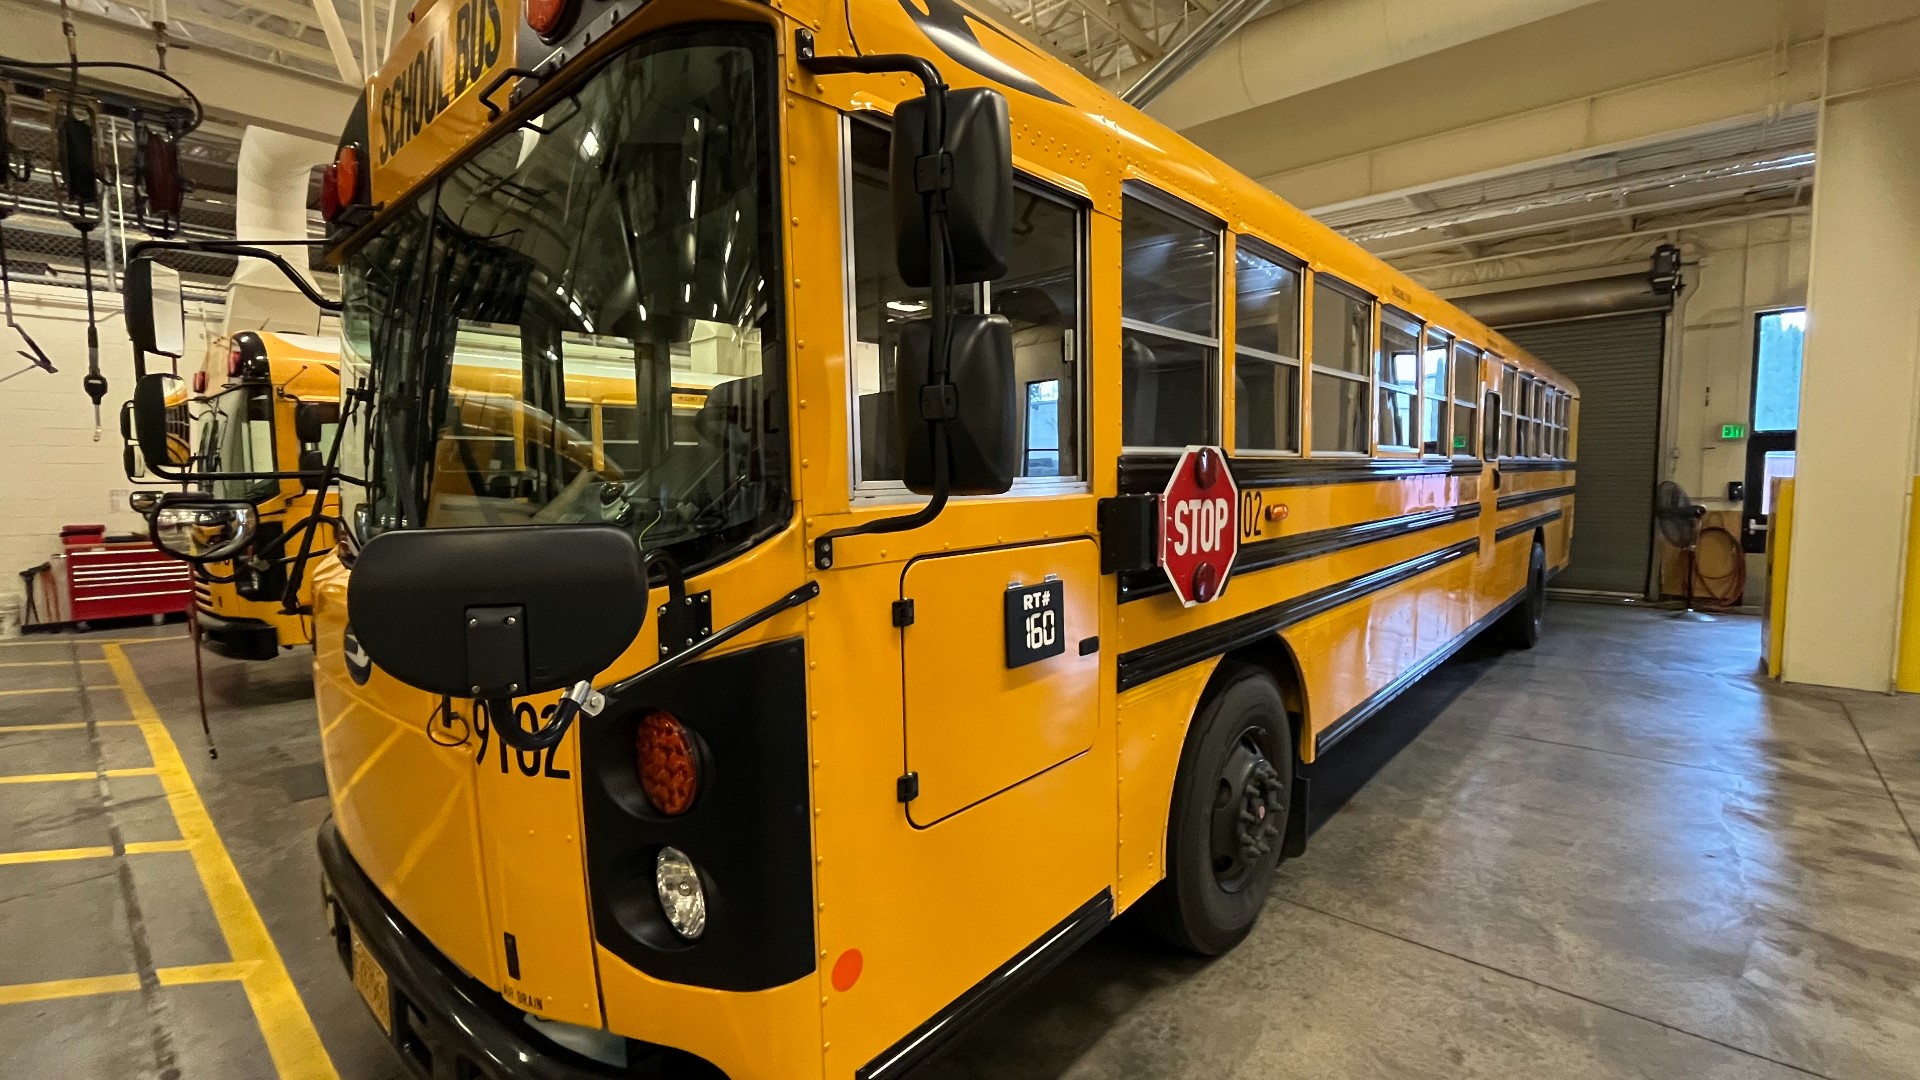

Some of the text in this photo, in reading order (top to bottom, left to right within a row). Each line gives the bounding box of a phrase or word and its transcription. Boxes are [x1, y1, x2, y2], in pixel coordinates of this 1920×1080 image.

[380, 0, 501, 165] SCHOOL BUS
[1174, 497, 1229, 557] STOP
[1023, 590, 1051, 611] RT#
[1025, 609, 1055, 650] 160
[517, 990, 543, 1010] DRAIN
